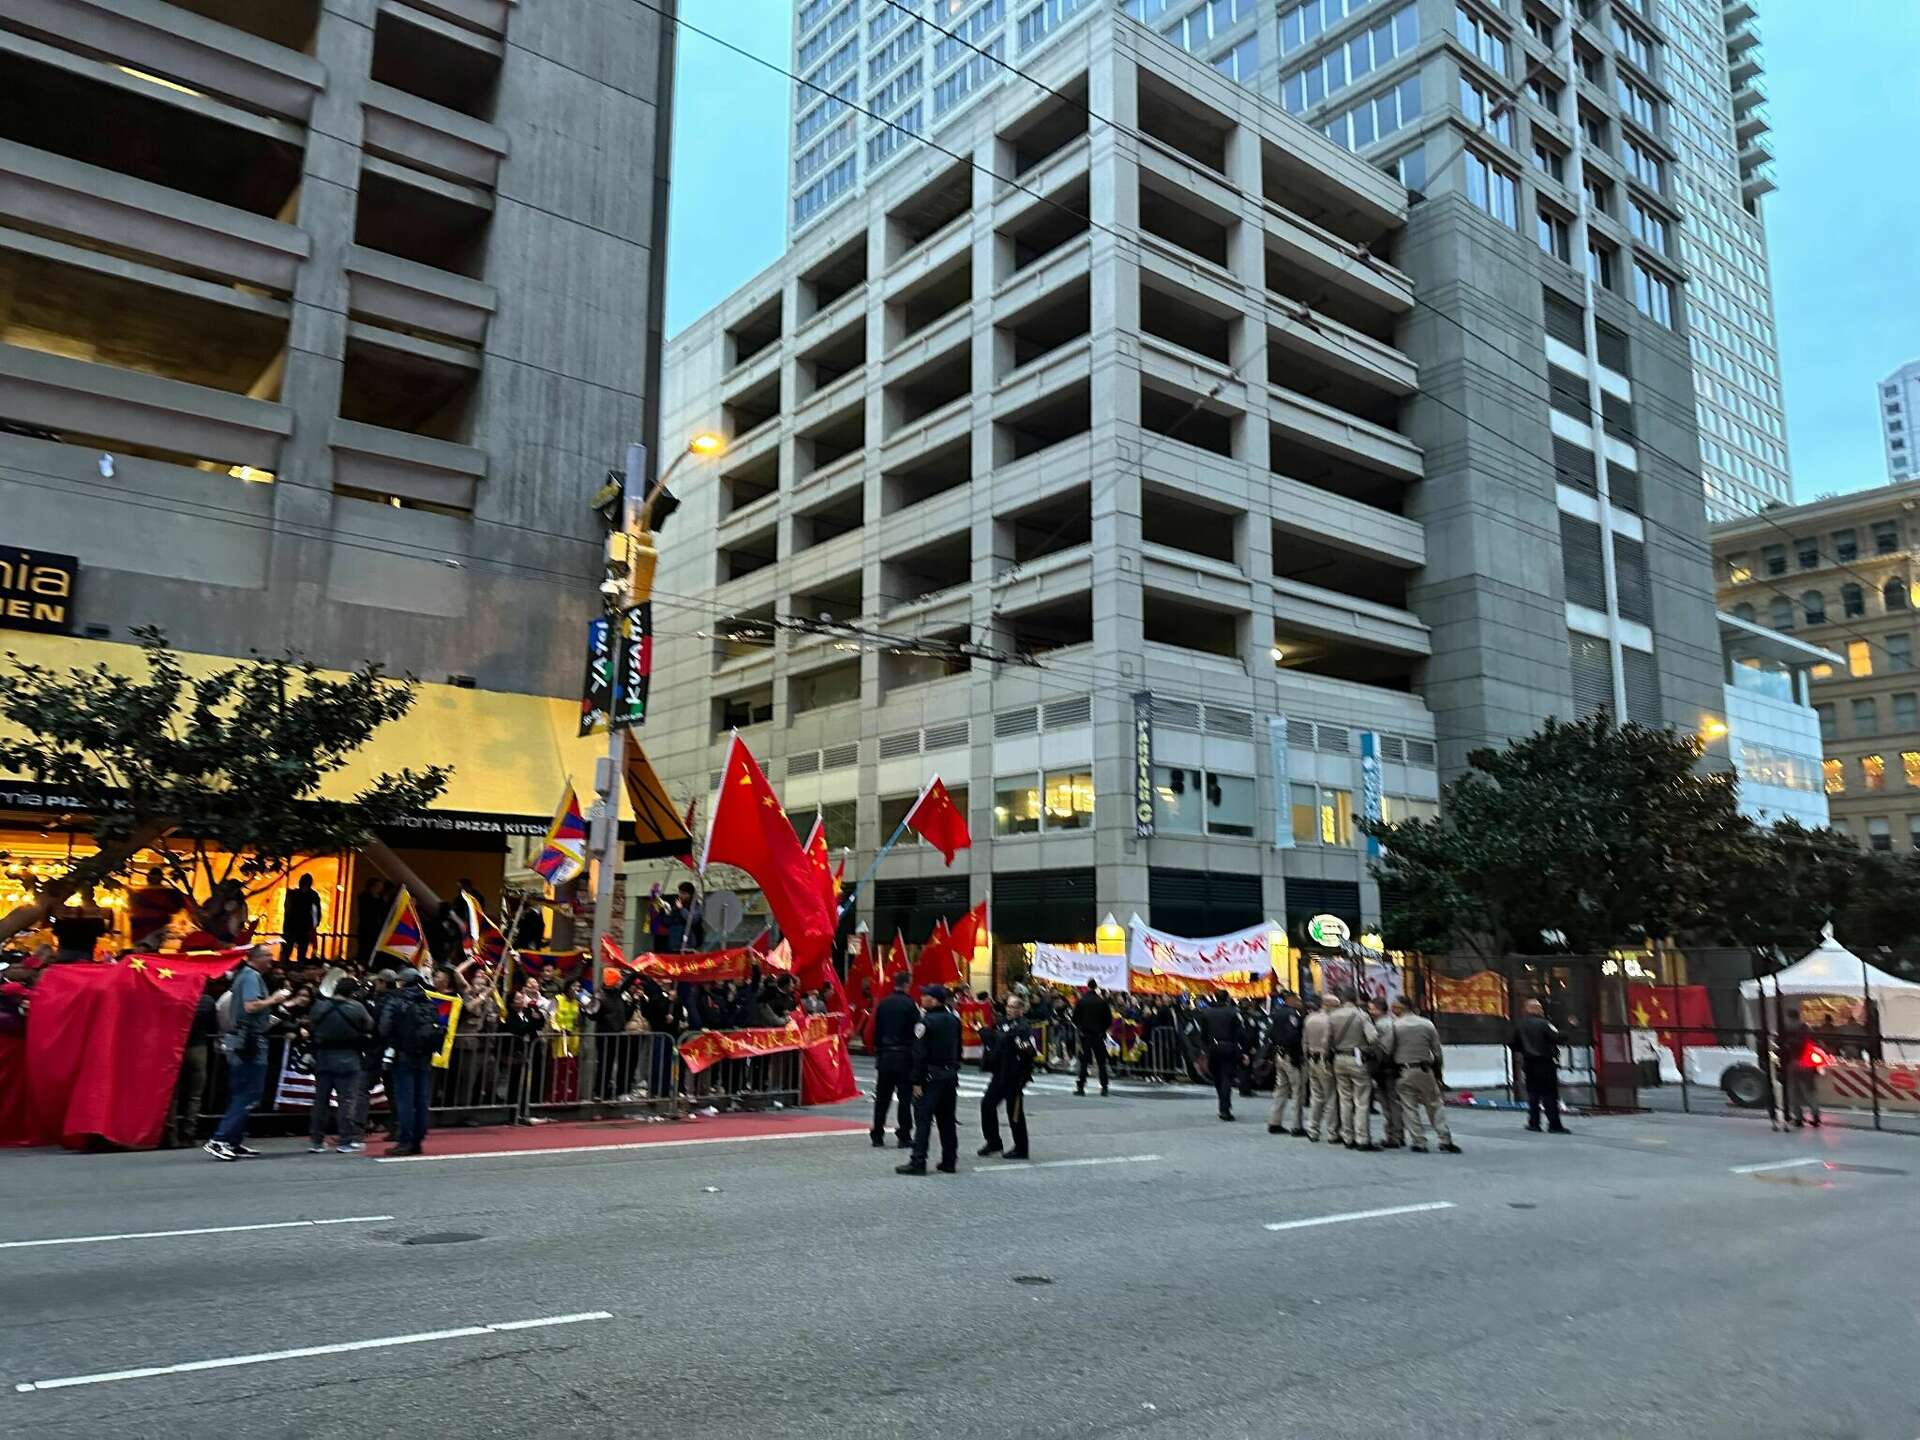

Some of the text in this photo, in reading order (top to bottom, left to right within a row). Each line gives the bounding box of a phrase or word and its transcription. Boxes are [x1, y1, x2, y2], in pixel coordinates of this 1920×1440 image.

[0, 597, 65, 623] EN
[625, 608, 643, 705] KUSAMA
[1137, 720, 1151, 801] PARKING
[454, 819, 502, 833] PIZZA
